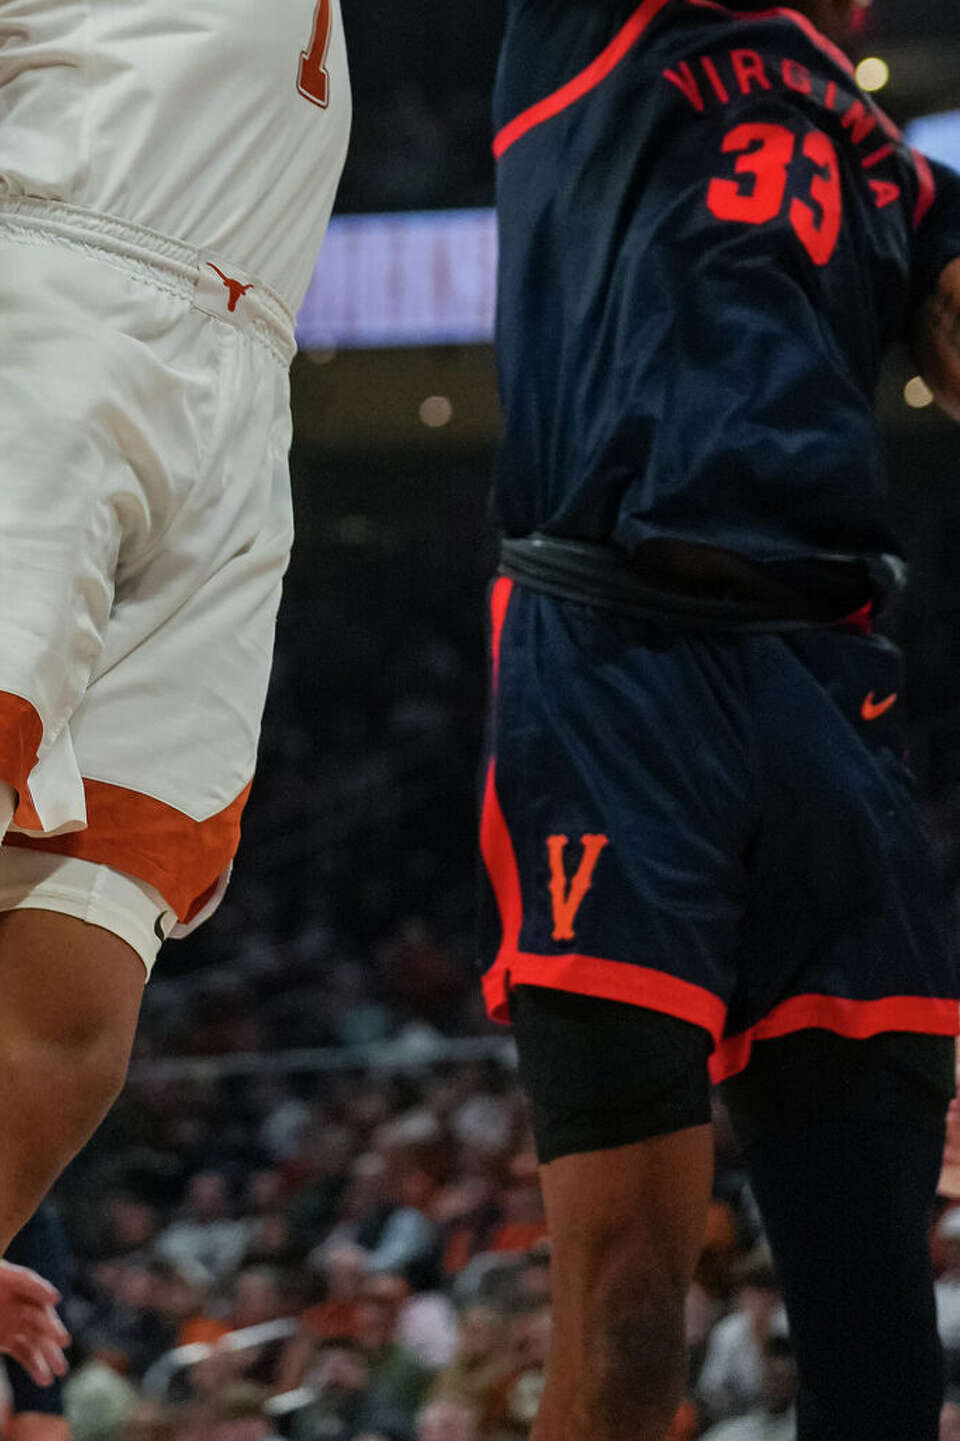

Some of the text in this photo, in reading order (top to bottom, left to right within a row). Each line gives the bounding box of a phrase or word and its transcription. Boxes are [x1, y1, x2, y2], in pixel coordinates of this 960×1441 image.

[662, 49, 900, 209] VIRGINIA
[706, 121, 842, 266] 33
[546, 834, 609, 941] V
